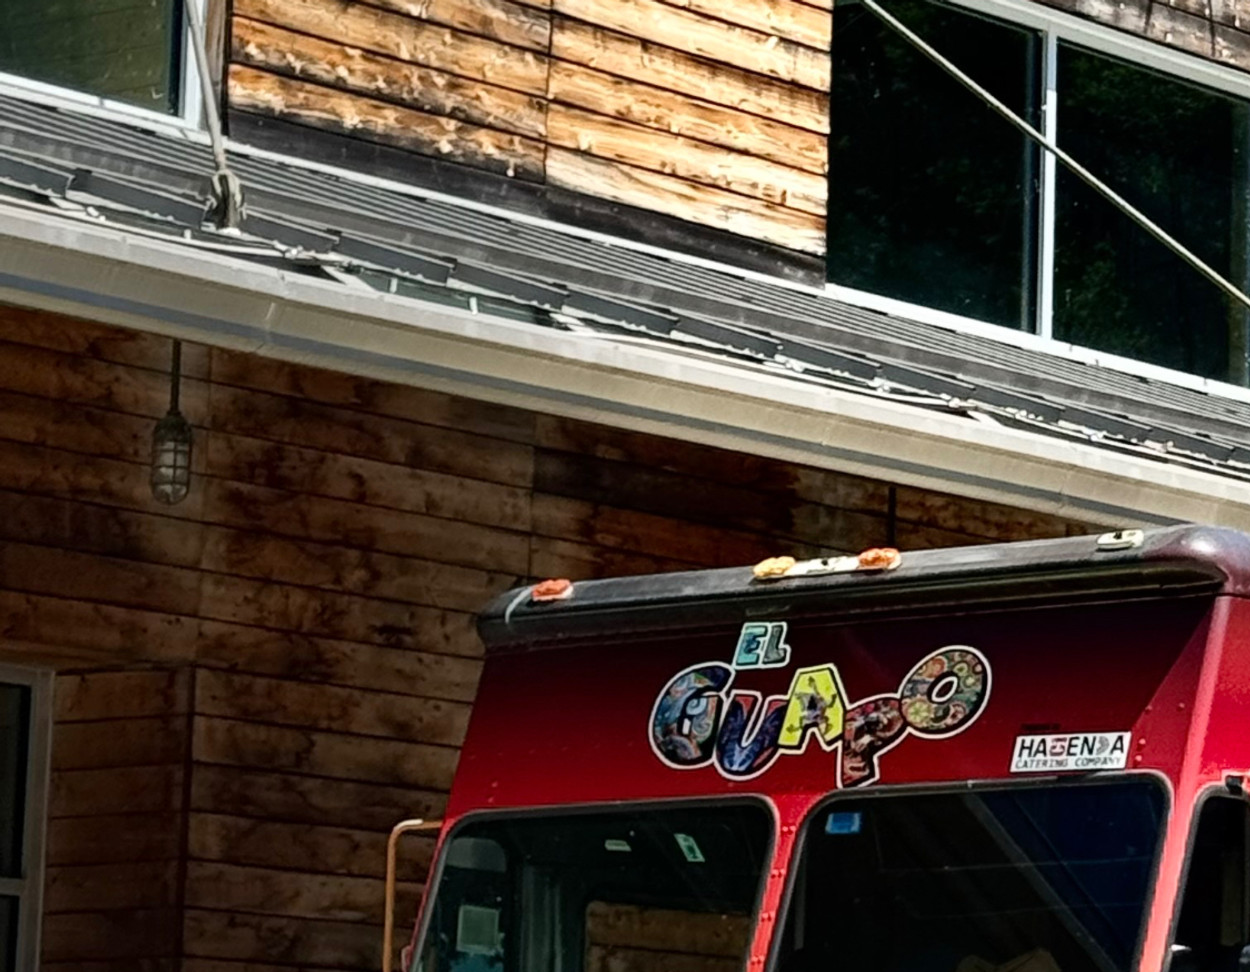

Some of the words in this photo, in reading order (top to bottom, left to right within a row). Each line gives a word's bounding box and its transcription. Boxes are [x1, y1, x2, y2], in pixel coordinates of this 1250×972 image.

[735, 622, 790, 668] EL
[649, 646, 992, 787] GUAPO
[1015, 758, 1069, 770] CATERING
[1074, 756, 1122, 768] COMPANY
